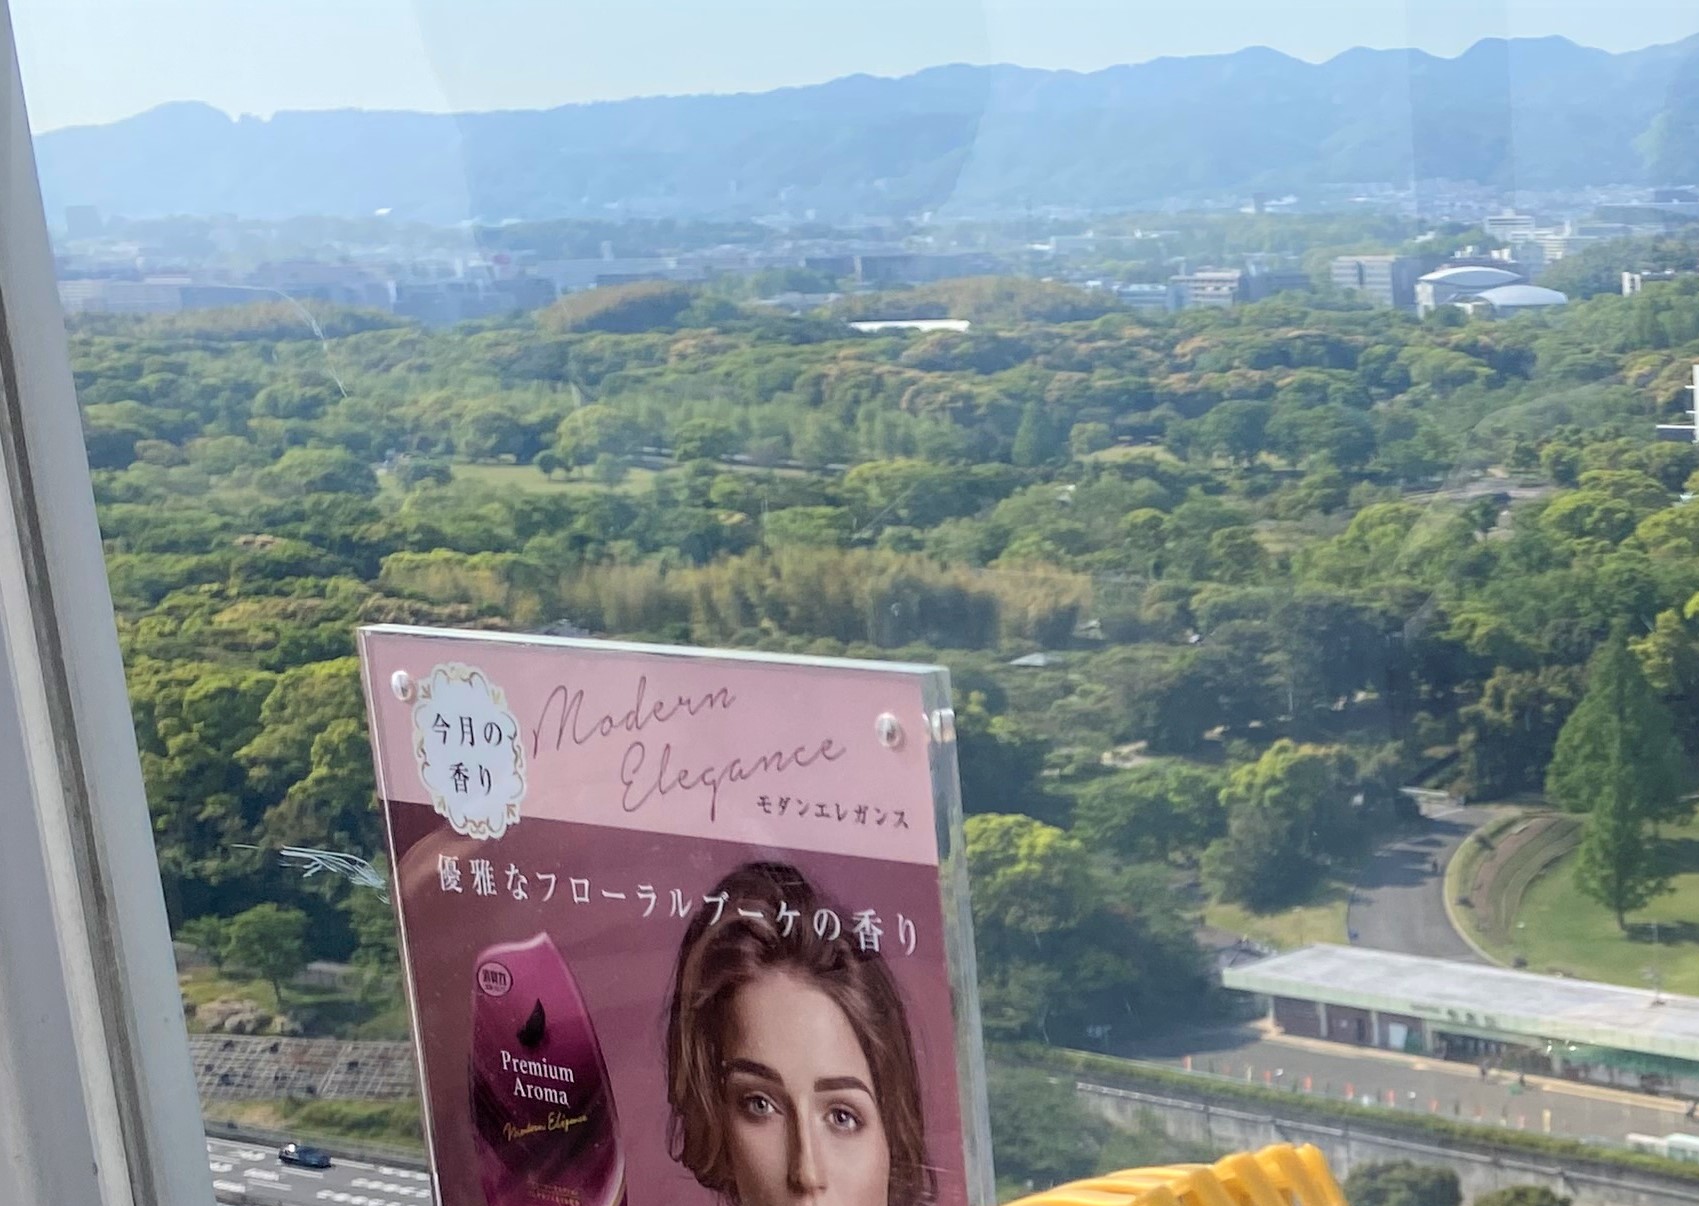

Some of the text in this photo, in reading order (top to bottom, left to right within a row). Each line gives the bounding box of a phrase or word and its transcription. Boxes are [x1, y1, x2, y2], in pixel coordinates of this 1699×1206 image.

[431, 713, 503, 747] 今月の
[532, 674, 737, 758] Modern
[449, 762, 495, 795] 香り
[621, 734, 846, 823] Elegance
[757, 793, 911, 830] モダンエレガンス
[436, 853, 919, 957] 優雅なフローラルブーケの香り
[500, 1049, 575, 1084] Premium
[513, 1076, 570, 1108] Aroma
